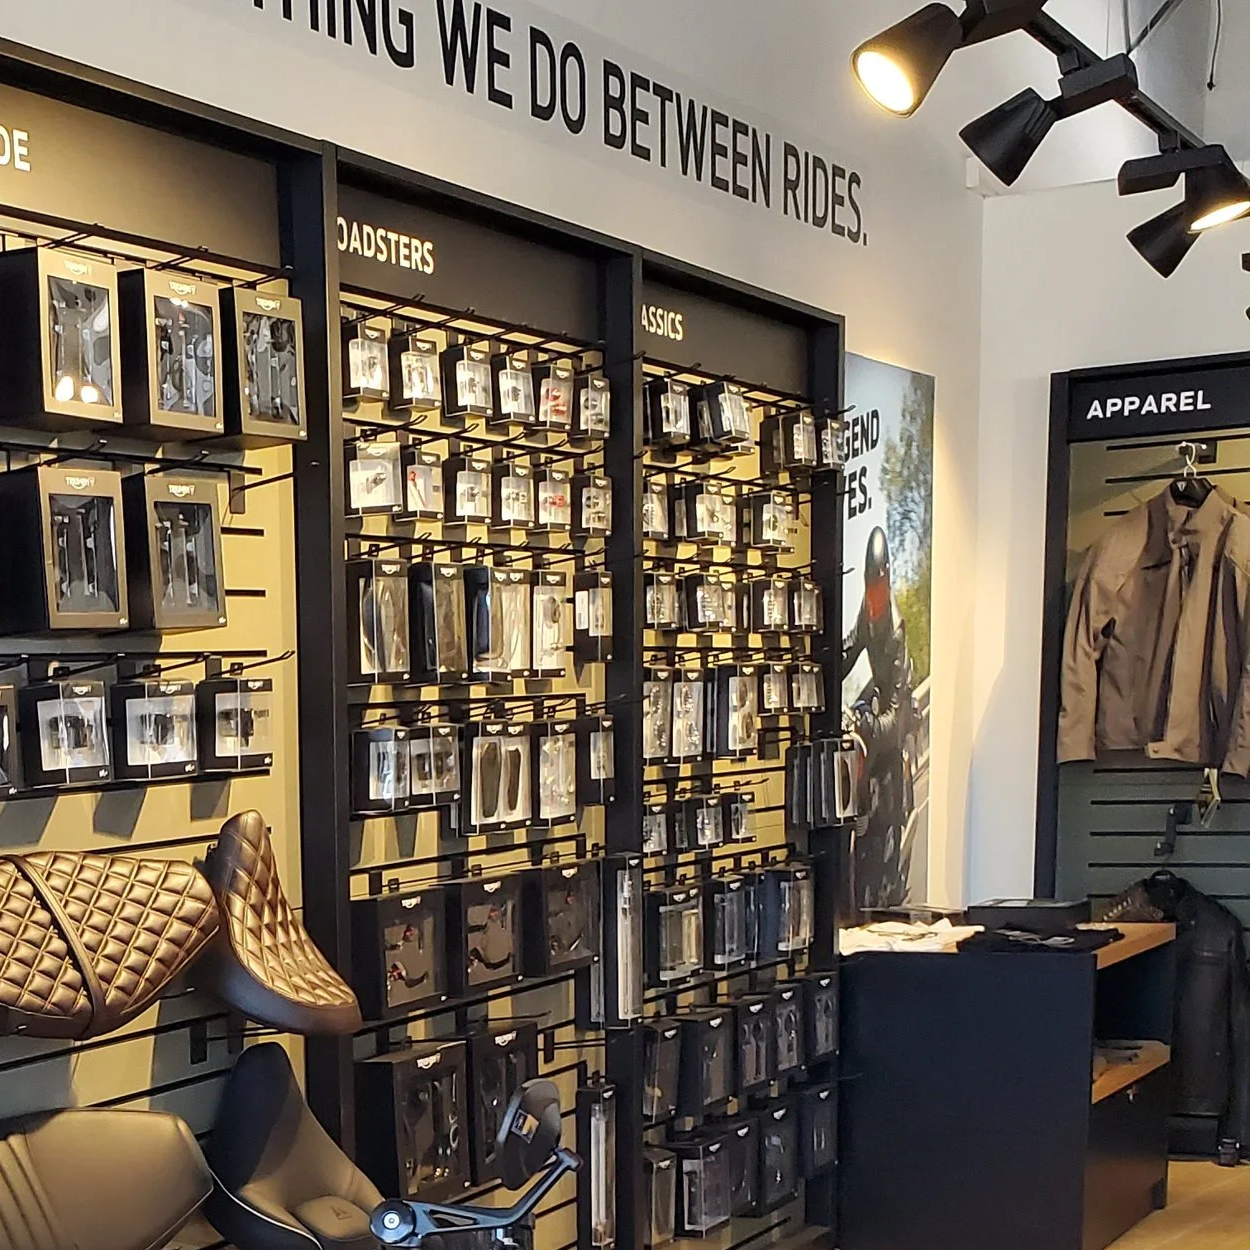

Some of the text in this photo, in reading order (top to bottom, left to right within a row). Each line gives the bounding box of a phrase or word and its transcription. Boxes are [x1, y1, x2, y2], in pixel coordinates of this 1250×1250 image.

[437, 0, 513, 110] WE
[529, 25, 587, 135] DO
[603, 58, 771, 209] BETWEEN
[783, 140, 869, 247] RIDES.
[1086, 389, 1212, 420] APPAREL
